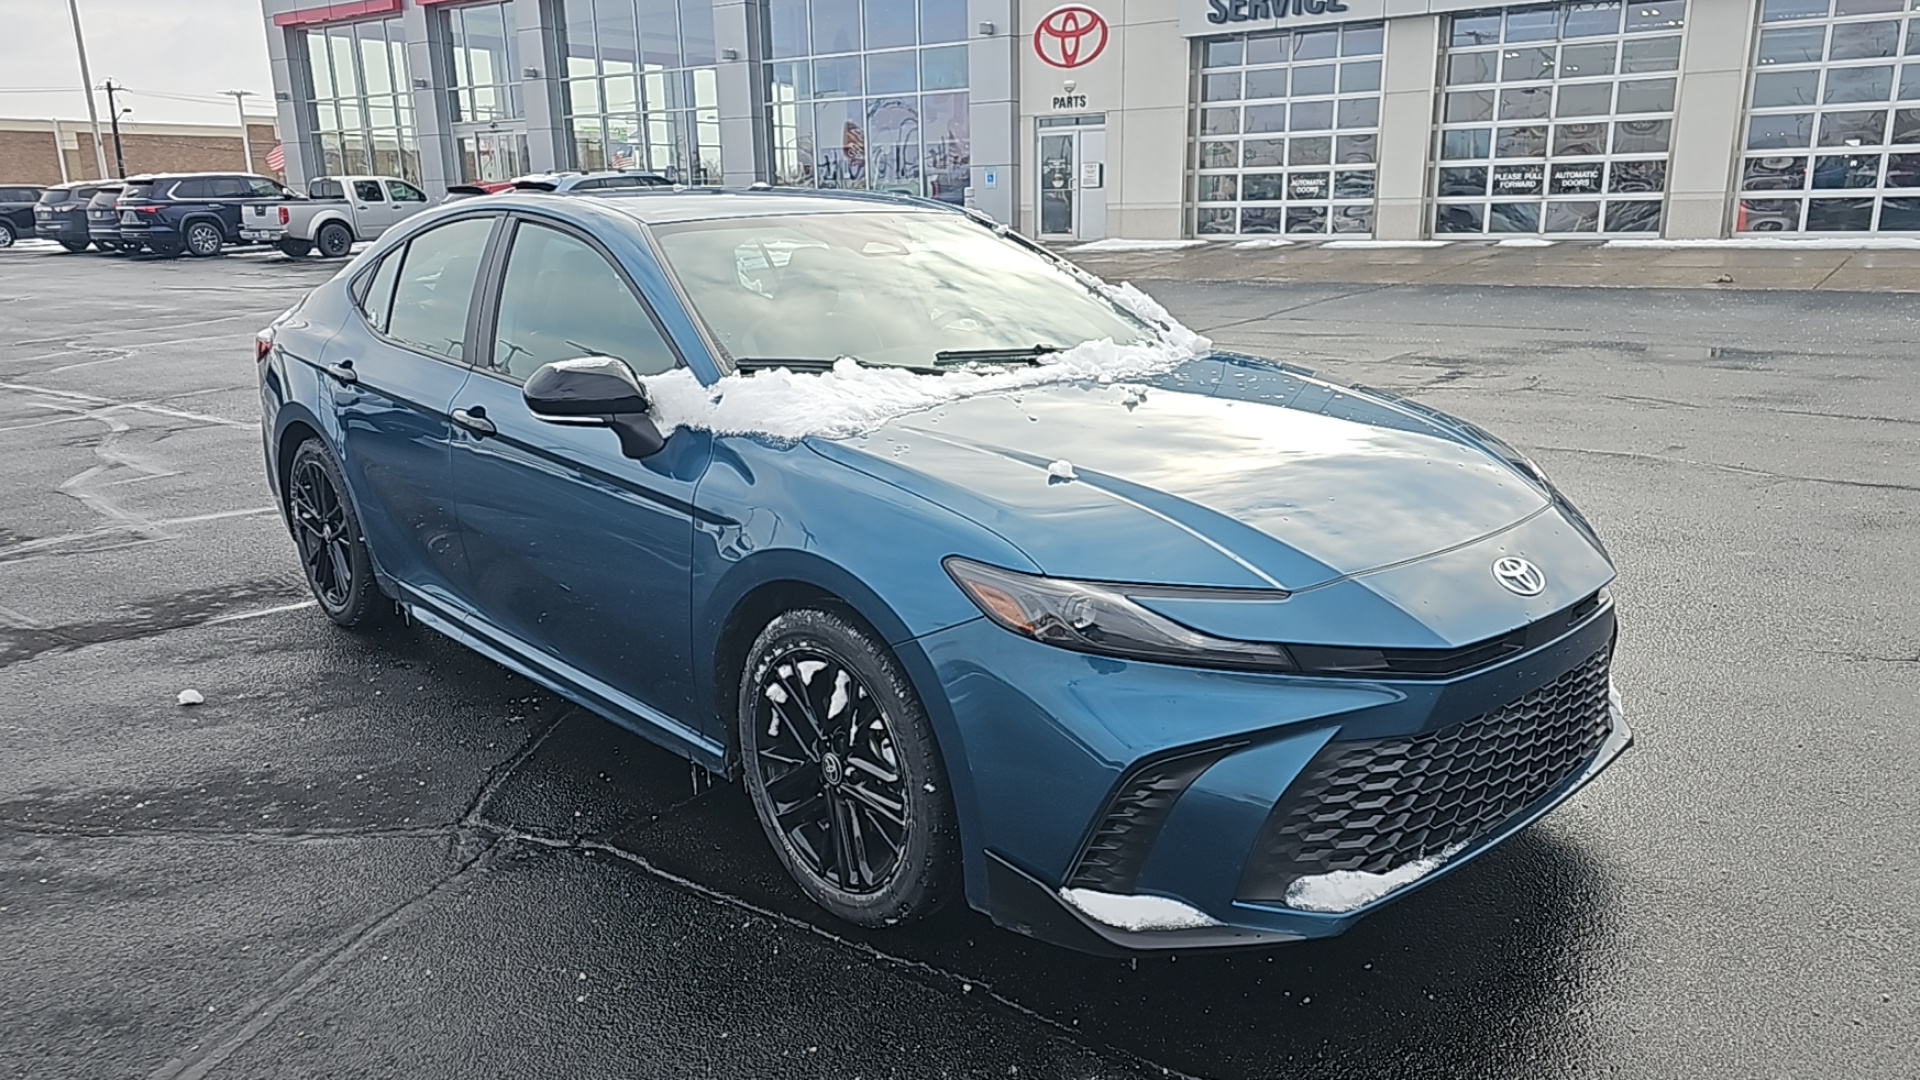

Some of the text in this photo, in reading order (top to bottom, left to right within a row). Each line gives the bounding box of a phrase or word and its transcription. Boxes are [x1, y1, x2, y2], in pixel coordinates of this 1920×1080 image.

[1052, 95, 1086, 109] PARTS
[1524, 172, 1543, 180] PULL
[1555, 171, 1599, 179] AUTOMATIC
[1500, 180, 1536, 188] FORWARD
[1562, 179, 1590, 187] DOORS
[1296, 186, 1319, 194] DOORS
